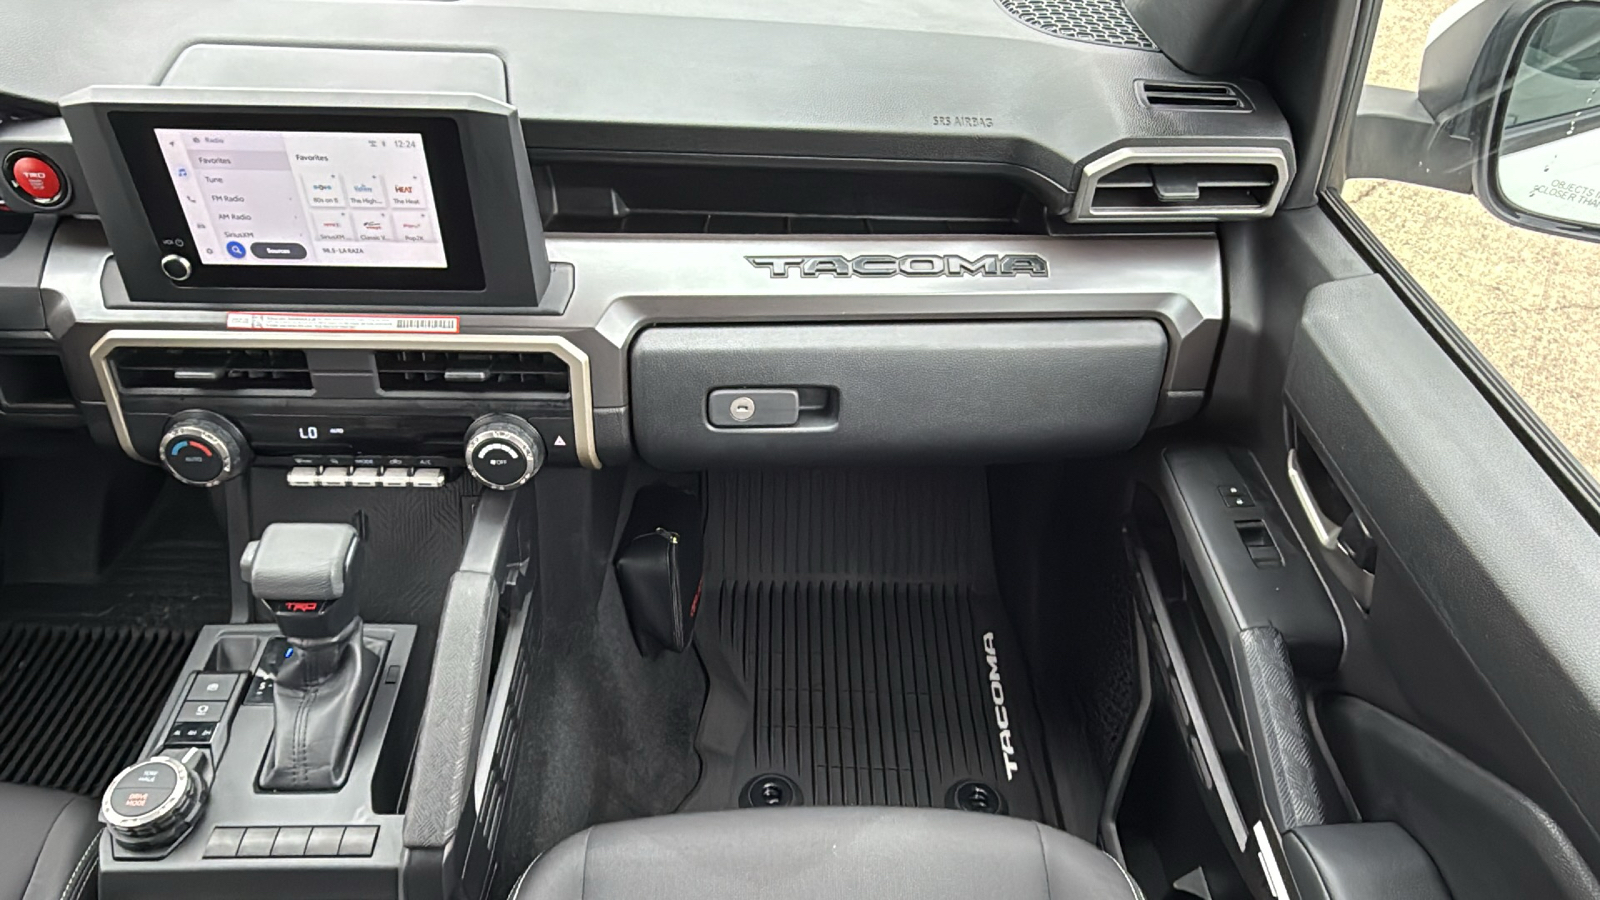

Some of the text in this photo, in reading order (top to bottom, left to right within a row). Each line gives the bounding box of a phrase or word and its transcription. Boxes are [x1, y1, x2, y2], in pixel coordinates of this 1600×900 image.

[933, 115, 994, 128] SRS AIRBAG
[394, 140, 416, 148] 12:24
[1537, 185, 1577, 202] CLOSER
[1551, 179, 1595, 197] OBJECTS
[744, 254, 1049, 278] TACOMA
[299, 426, 318, 439] LO
[285, 602, 318, 612] TRD
[983, 632, 1018, 781] TACOMA
